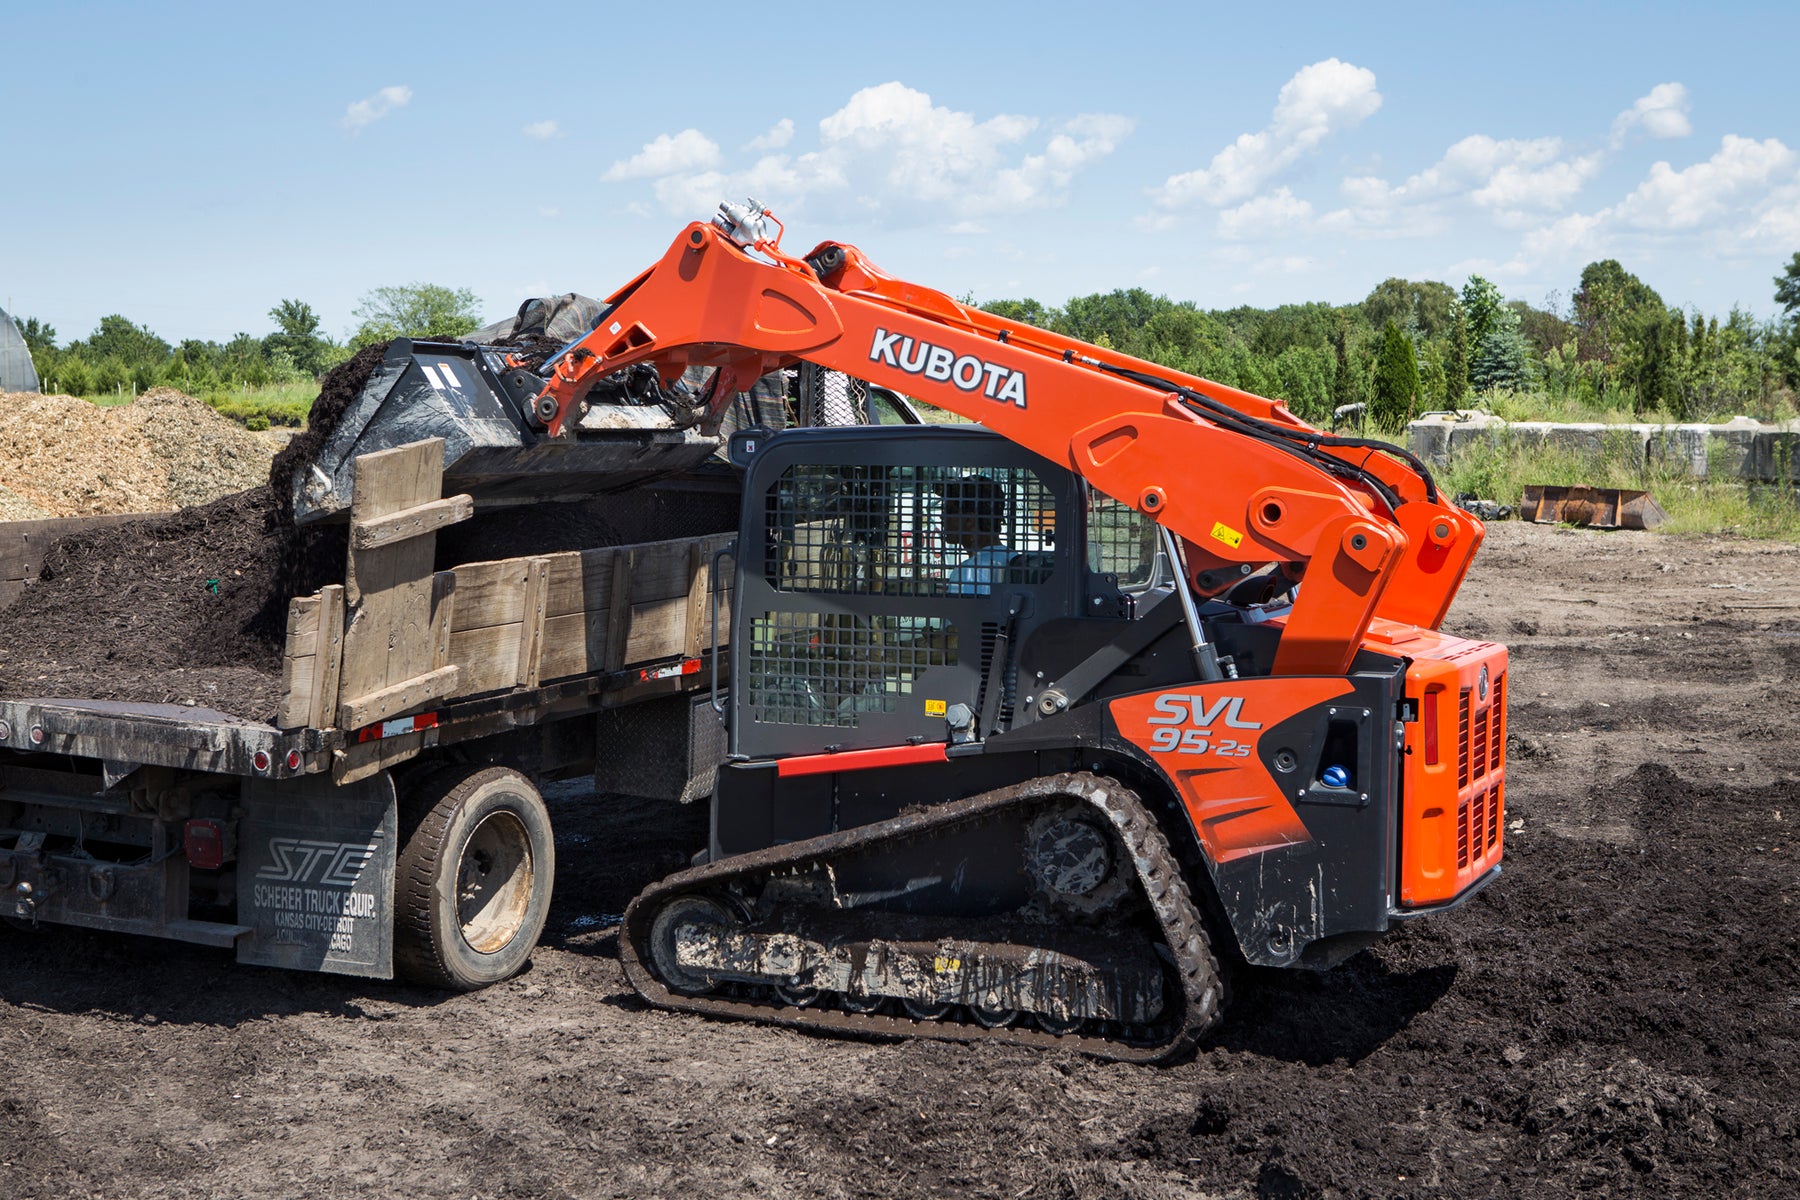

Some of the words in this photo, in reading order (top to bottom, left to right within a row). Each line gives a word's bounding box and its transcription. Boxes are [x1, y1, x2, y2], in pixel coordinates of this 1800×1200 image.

[869, 327, 1027, 409] KUBOTA
[1147, 693, 1263, 729] SVL
[256, 837, 378, 887] STE
[254, 885, 302, 910] SCHERER
[305, 890, 341, 913] TRUCK
[342, 892, 377, 919] EQUIP.
[275, 912, 304, 929] KANSAS
